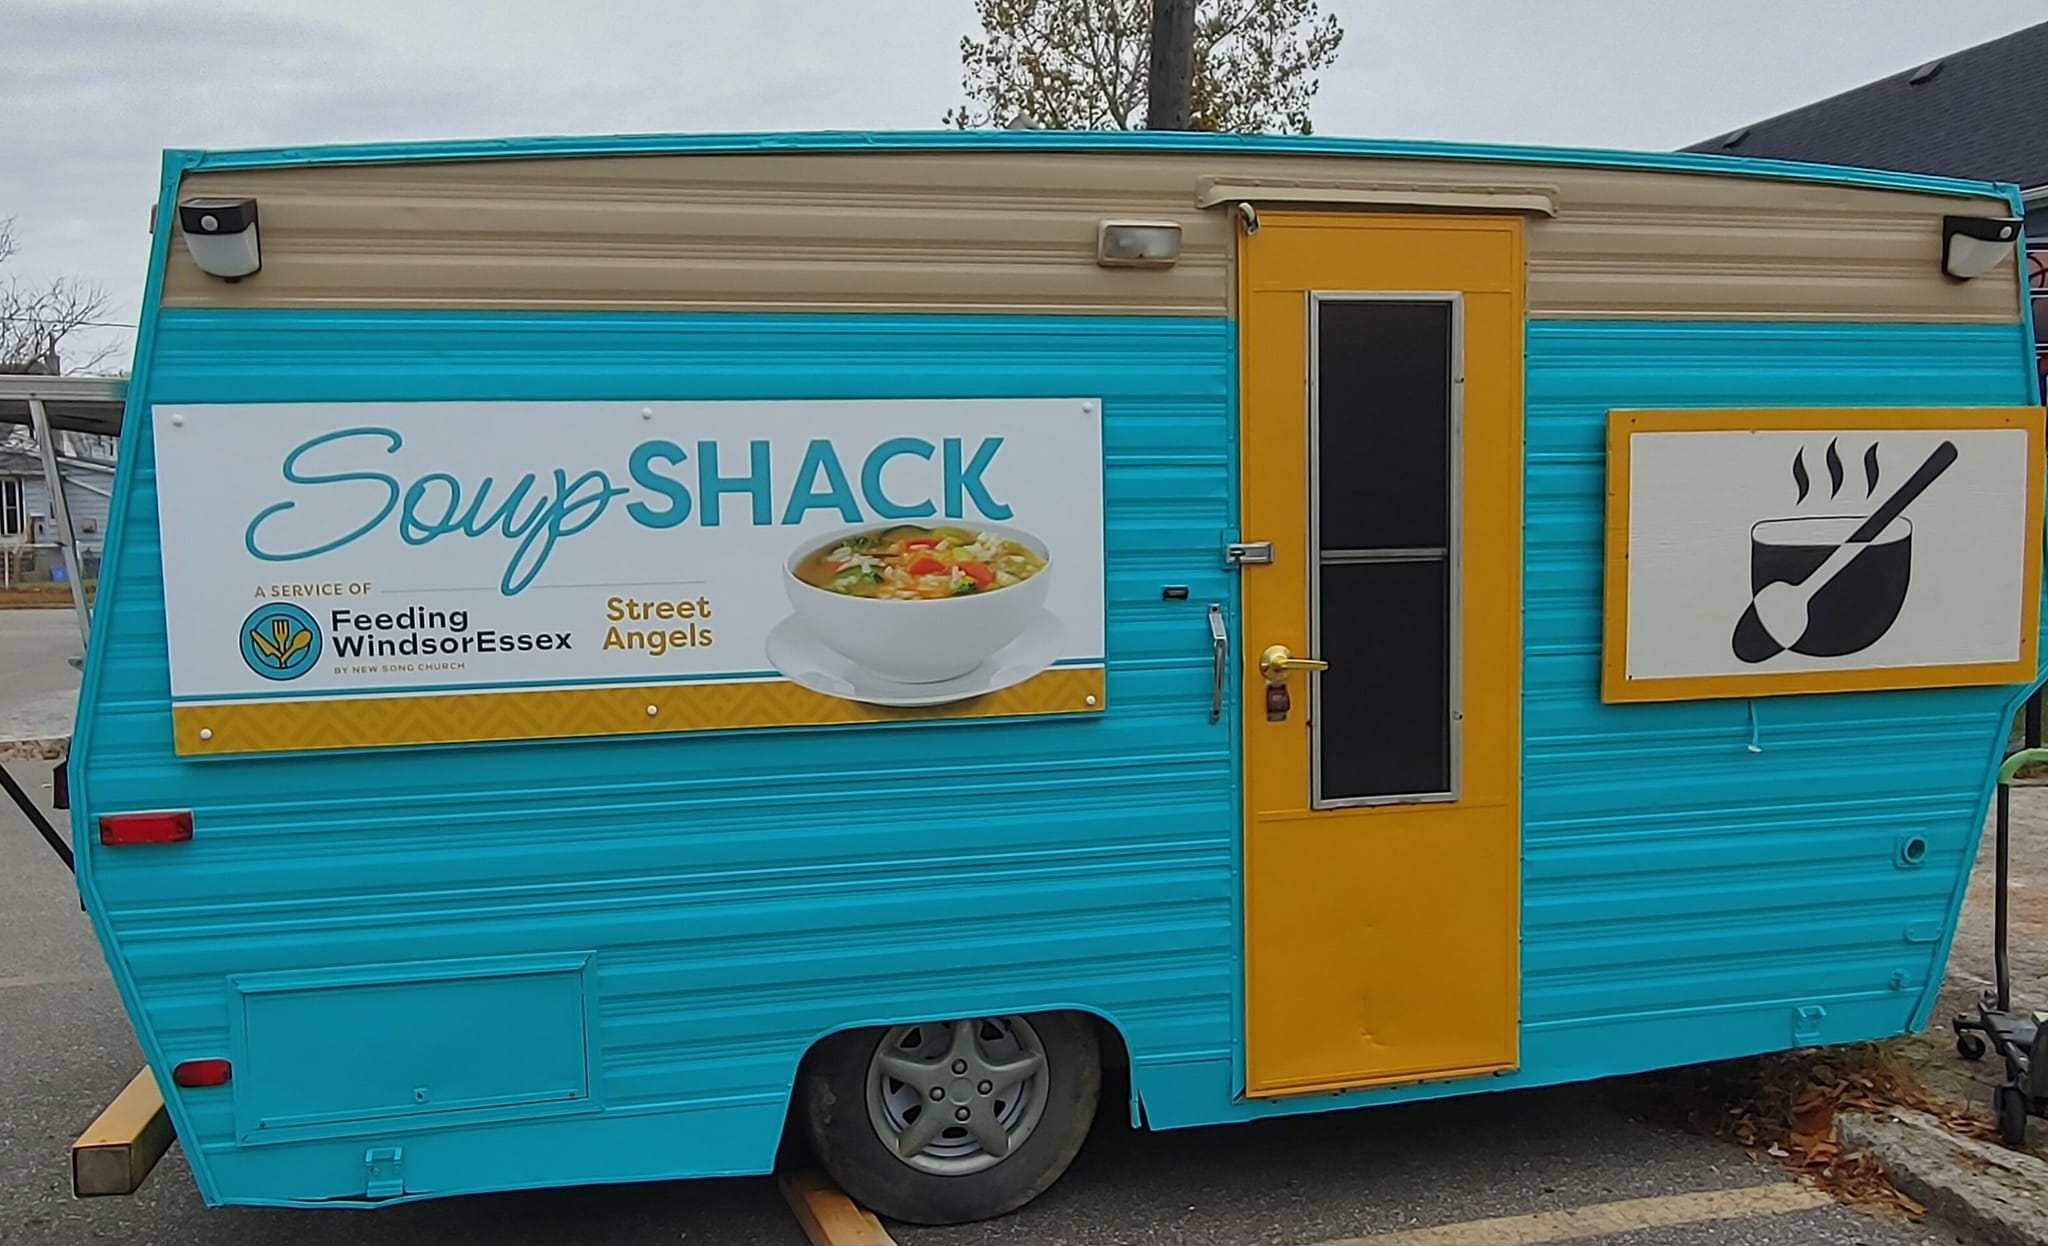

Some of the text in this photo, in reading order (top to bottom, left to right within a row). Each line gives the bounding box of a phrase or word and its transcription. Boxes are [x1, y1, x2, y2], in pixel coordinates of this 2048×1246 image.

[255, 583, 373, 598] A SERVICE OF
[331, 606, 468, 633] Feeding
[606, 597, 711, 622] Street
[333, 630, 572, 658] WindsorEssex
[603, 624, 713, 656] Angels
[334, 662, 466, 674] BY NEW SONG CHURCH
